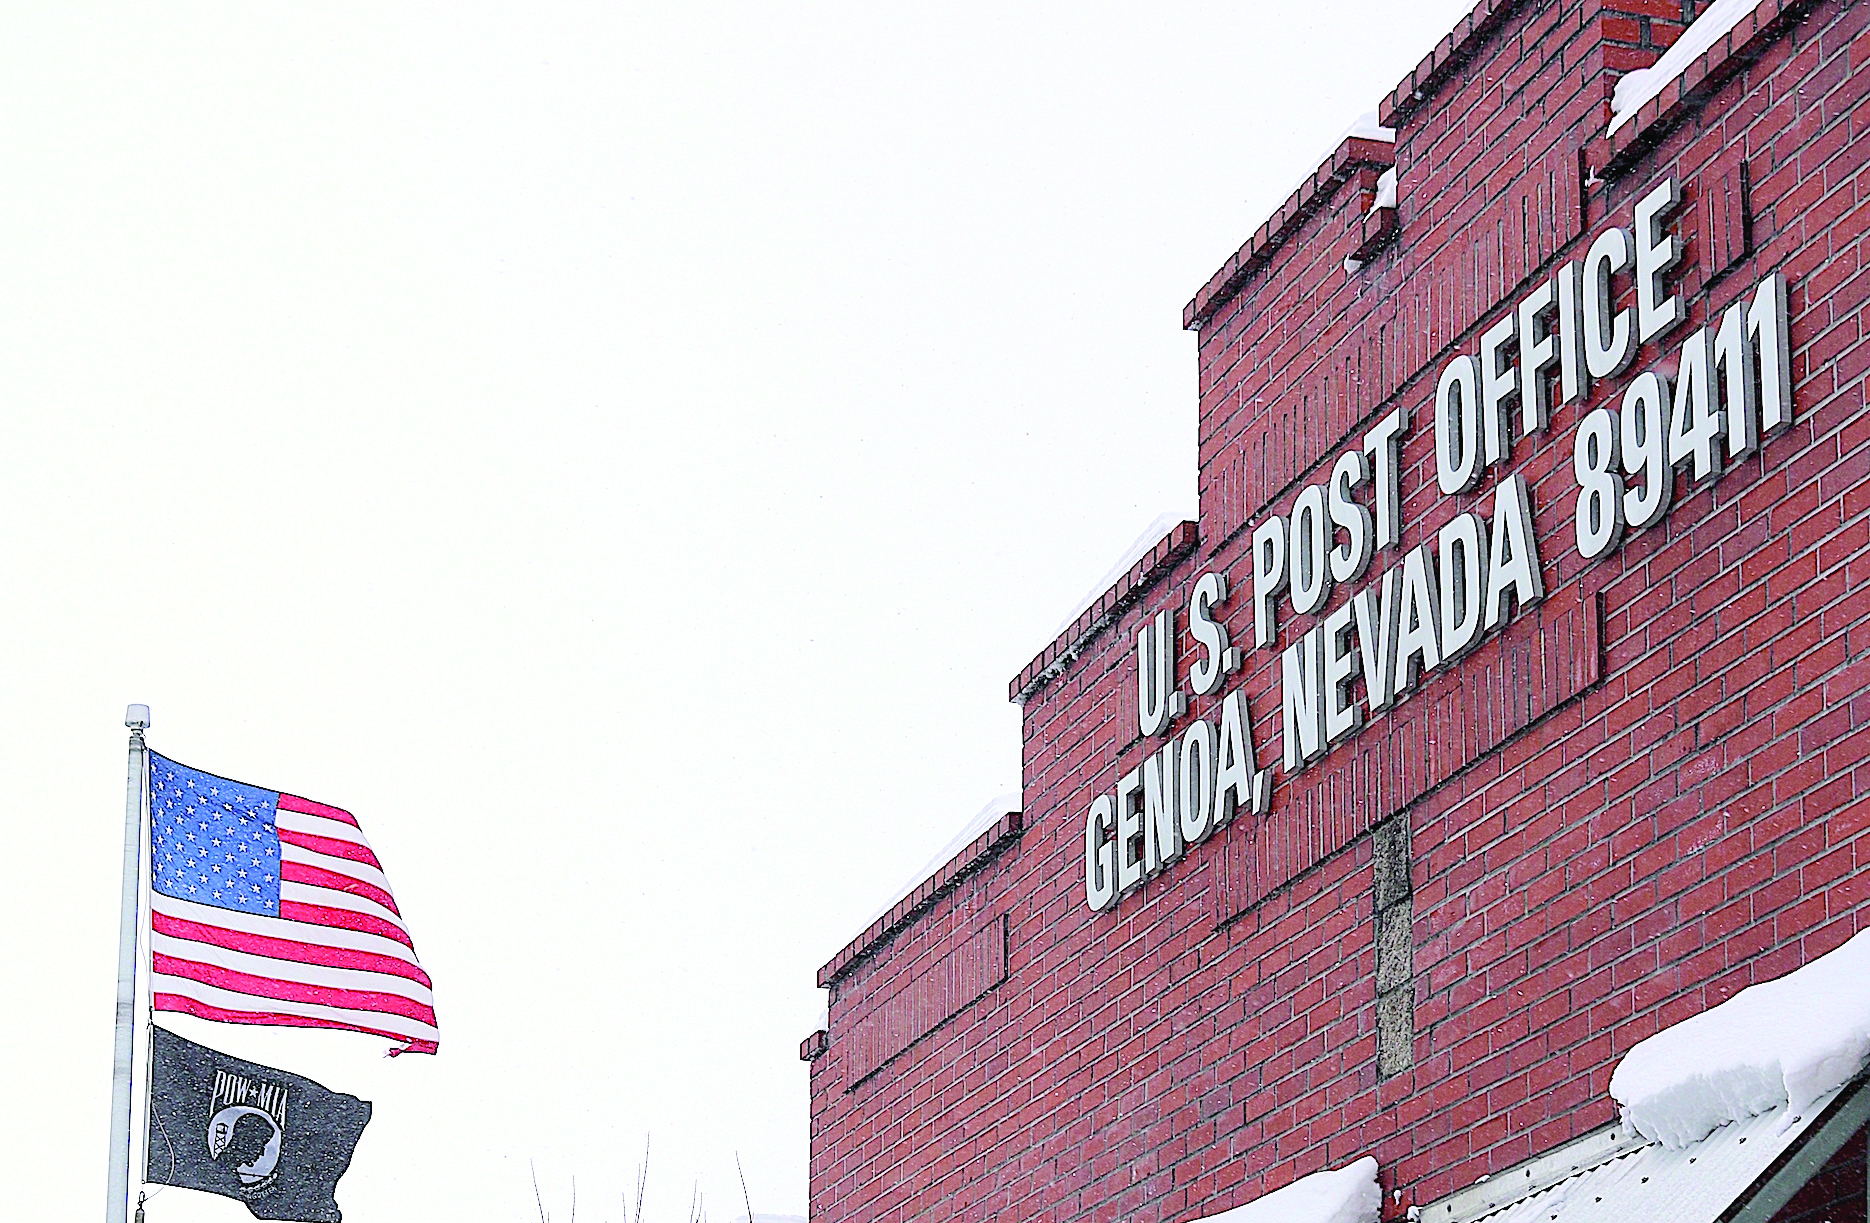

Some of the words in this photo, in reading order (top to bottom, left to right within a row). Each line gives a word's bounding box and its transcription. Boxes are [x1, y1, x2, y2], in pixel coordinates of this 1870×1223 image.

[1084, 688, 1274, 913] GENOA,
[1281, 473, 1544, 774] NEVADA
[1573, 272, 1794, 559] 89411
[1136, 608, 1187, 738] U.
[1189, 572, 1242, 696] S.
[1252, 407, 1408, 650] POST
[1435, 177, 1686, 496] OFFICE
[209, 1069, 252, 1118] POW
[256, 1083, 288, 1131] MIA
